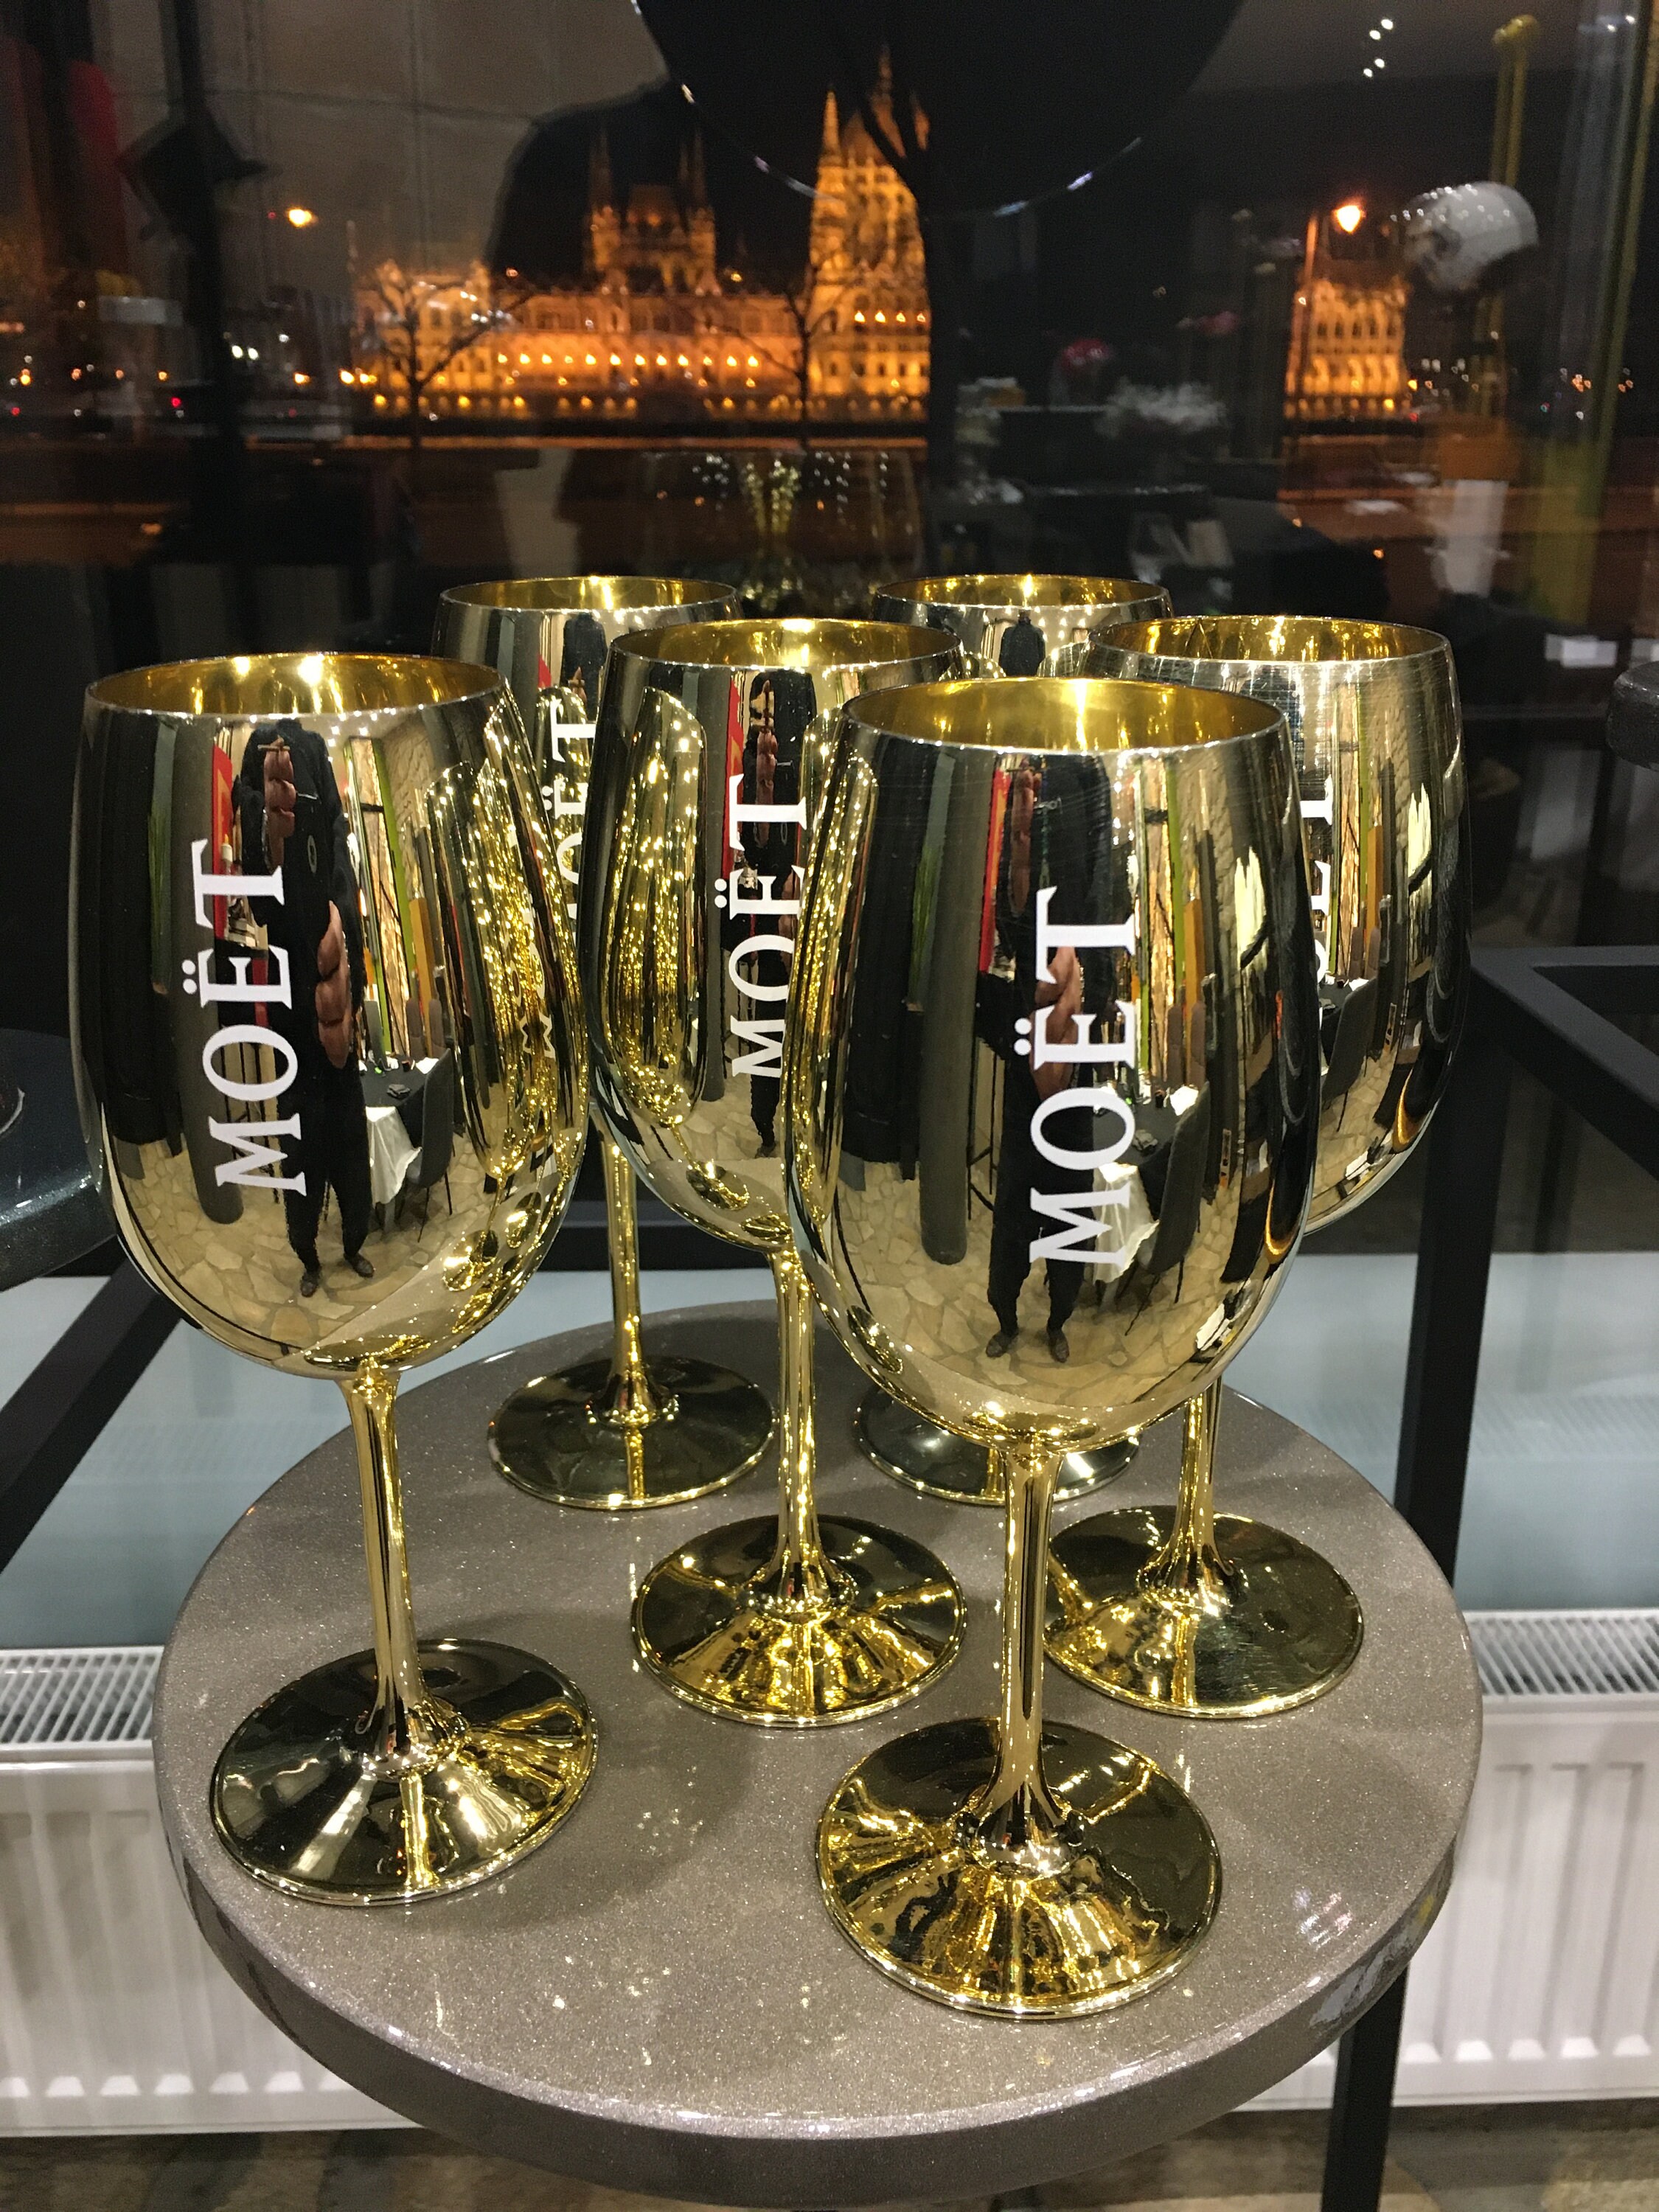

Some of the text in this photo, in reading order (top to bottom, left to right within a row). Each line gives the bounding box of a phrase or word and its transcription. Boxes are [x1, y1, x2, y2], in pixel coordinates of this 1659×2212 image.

[181, 838, 307, 1197] MOËT
[713, 772, 807, 1079] MOËT
[1013, 886, 1136, 1273] MOËT
